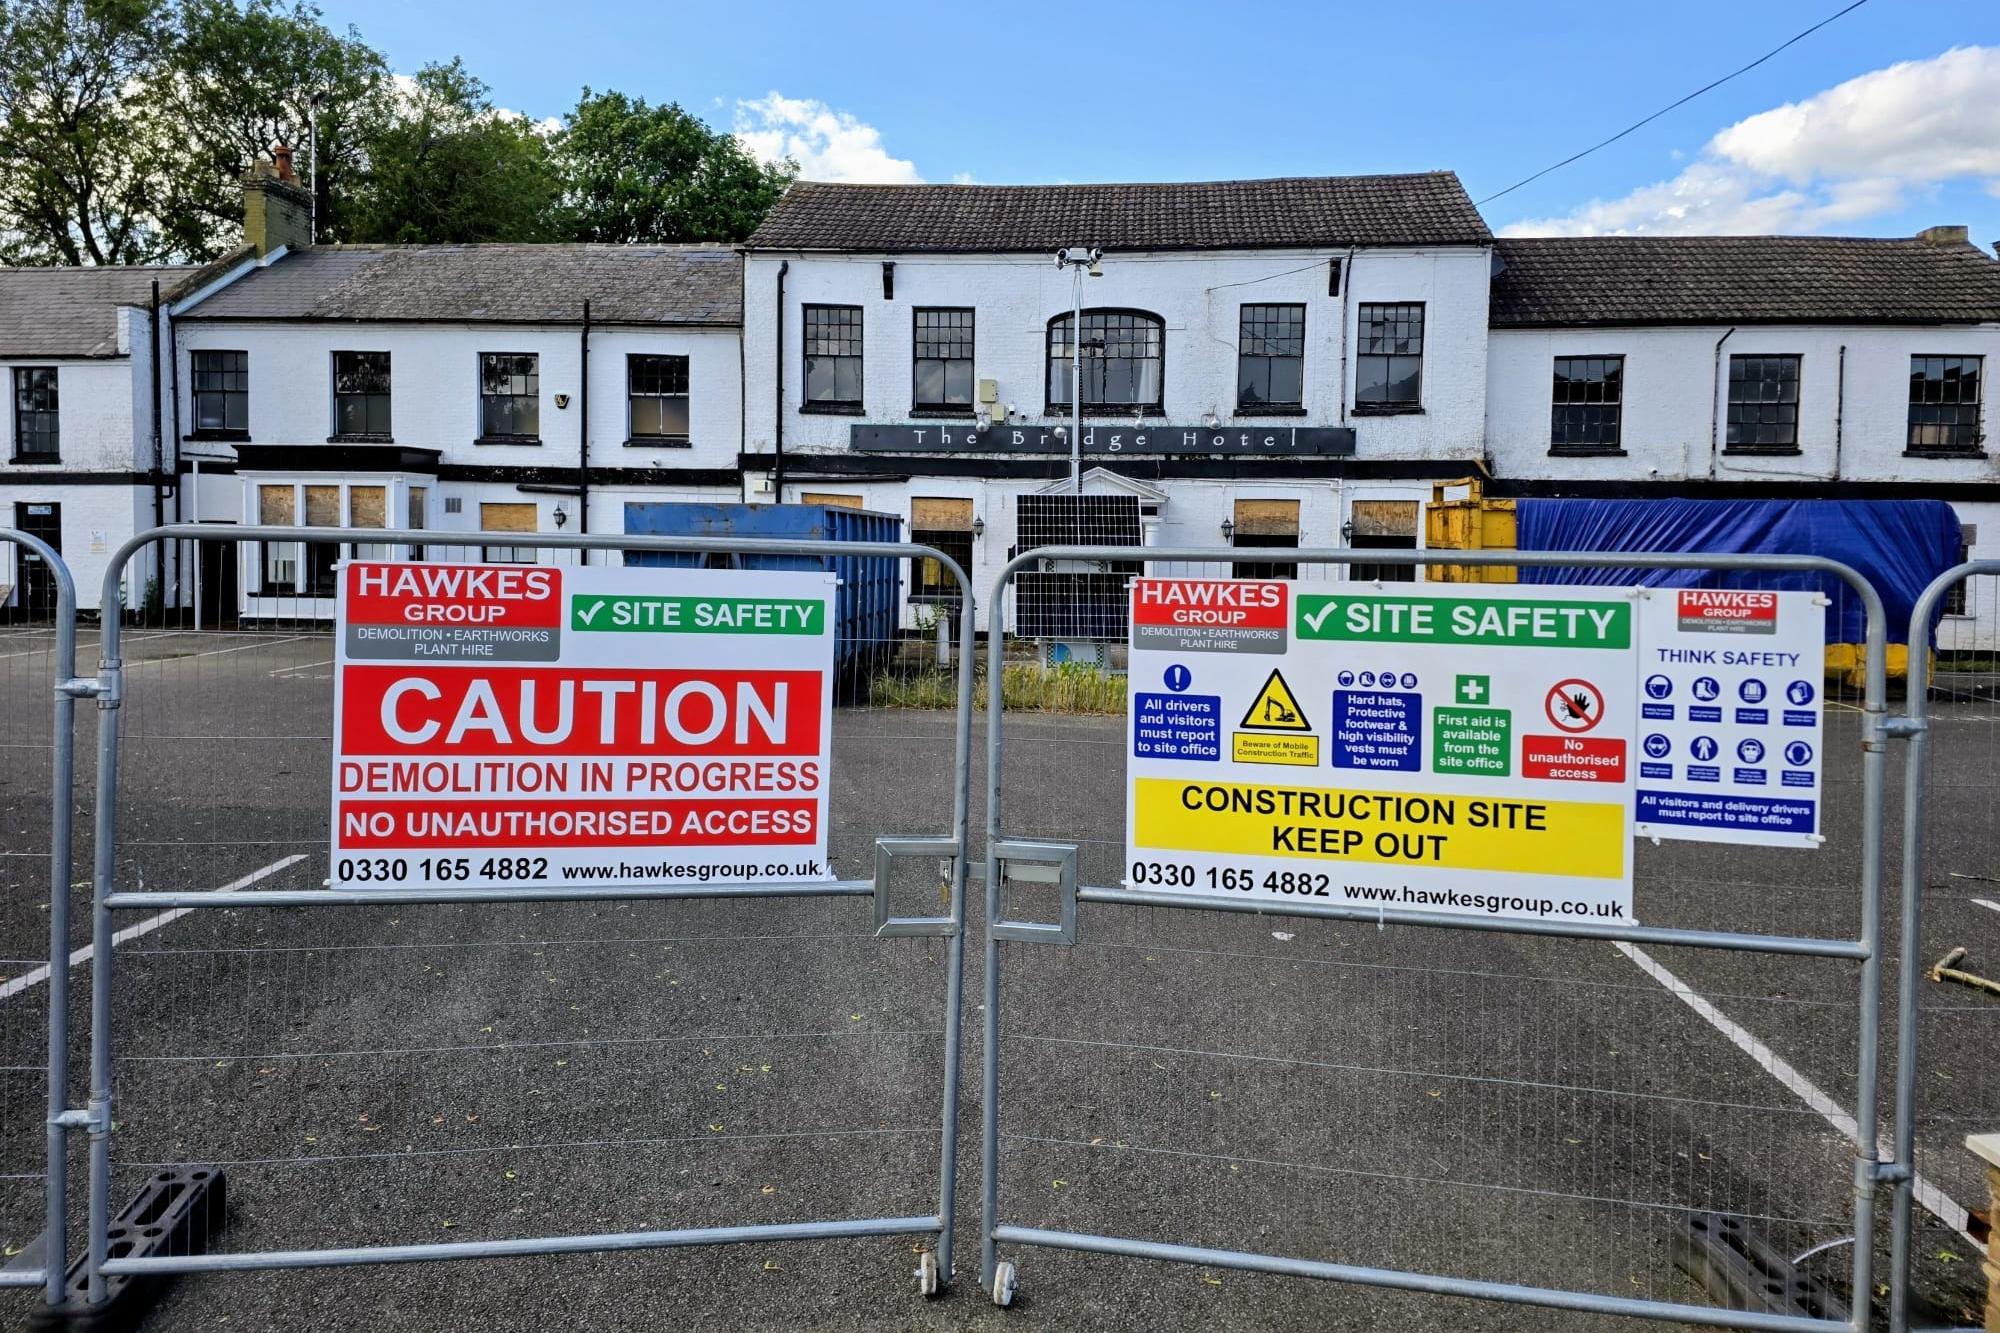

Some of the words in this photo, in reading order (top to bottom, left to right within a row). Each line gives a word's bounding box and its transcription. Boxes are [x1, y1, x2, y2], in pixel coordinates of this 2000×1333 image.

[914, 427, 977, 445] The
[1012, 428, 1146, 451] Bridge
[1183, 428, 1296, 446] Hotel
[359, 567, 551, 599] HAWKES
[1141, 582, 1280, 607] HAWKES
[1683, 592, 1773, 608] HAWKES
[404, 604, 506, 622] GROUP
[612, 601, 681, 626] SITE
[695, 603, 814, 628] SAFETY
[1173, 609, 1246, 624] GROUP
[1703, 608, 1751, 617] GROUP
[1346, 604, 1434, 635] SITE
[1452, 606, 1616, 640] SAFETY
[358, 627, 443, 641] DEMOLITION
[454, 630, 549, 643] EARTHWORKS
[1141, 627, 1202, 639] DEMOLITION
[1208, 629, 1279, 640] EARTHWORKS
[414, 643, 458, 655] PLANT
[461, 644, 494, 656] HIRE
[1180, 639, 1212, 648] PLANT
[1213, 640, 1237, 649] HIRE
[1657, 649, 1716, 664] THINK
[1723, 651, 1800, 667] SAFETY
[1145, 699, 1161, 710] All
[1166, 700, 1210, 712] drivers
[1347, 695, 1373, 706] Hard
[1378, 696, 1406, 708] hats,
[381, 677, 788, 745] CAUTION
[1347, 708, 1406, 719] Protective
[1140, 713, 1163, 724] and
[1167, 715, 1215, 727] visitors
[1346, 719, 1396, 731] footwear
[1399, 720, 1407, 731] &
[1438, 714, 1468, 726] First
[1471, 716, 1491, 727] aid
[1496, 716, 1506, 728] is
[1140, 728, 1173, 739] must
[1175, 729, 1215, 742] report
[1338, 730, 1362, 745] high
[1366, 732, 1415, 746] visibility
[1443, 728, 1501, 741] available
[1138, 741, 1150, 752] to
[1154, 742, 1177, 753] site
[1181, 743, 1217, 755] office
[1243, 740, 1270, 748] Beware
[1345, 743, 1375, 754] vests
[1378, 744, 1408, 755] must
[1444, 742, 1473, 754] from
[1478, 743, 1499, 755] the
[1564, 739, 1584, 751] No
[1237, 748, 1287, 757] Construction
[1289, 751, 1313, 759] Traffic
[1528, 753, 1619, 767] unauthorised
[1353, 756, 1366, 766] be
[1370, 758, 1399, 768] worn
[1439, 756, 1462, 767] site
[1466, 757, 1503, 769] office
[340, 762, 567, 793] DEMOLITION
[581, 763, 613, 791] IN
[627, 762, 819, 792] PROGRESS
[1549, 769, 1597, 779] access
[1182, 786, 1455, 825] CONSTRUCTION
[1467, 803, 1547, 831] SITE
[1641, 796, 1656, 806] All
[1659, 797, 1699, 809] visitors
[1702, 800, 1722, 810] and
[1725, 801, 1768, 814] delivery
[1771, 803, 1811, 815] drivers
[345, 812, 394, 837] NO
[406, 811, 672, 837] UNAUTHORISED
[681, 810, 811, 835] ACCESS
[1658, 809, 1687, 818] must
[1688, 811, 1722, 821] report
[1725, 812, 1735, 821] to
[1738, 813, 1759, 823] site
[1761, 814, 1792, 825] office
[1273, 826, 1363, 857] KEEP
[1374, 832, 1448, 861] OUT
[338, 858, 408, 882] 0330
[419, 858, 470, 881] 165
[479, 857, 548, 880] 4882
[562, 860, 819, 881] www.hawkesgroup.co.uk
[1131, 862, 1195, 887] 0330
[1206, 867, 1254, 891] 165
[1263, 871, 1330, 896] 4882
[1344, 883, 1624, 918] www.hawkesgroup.co.uk
